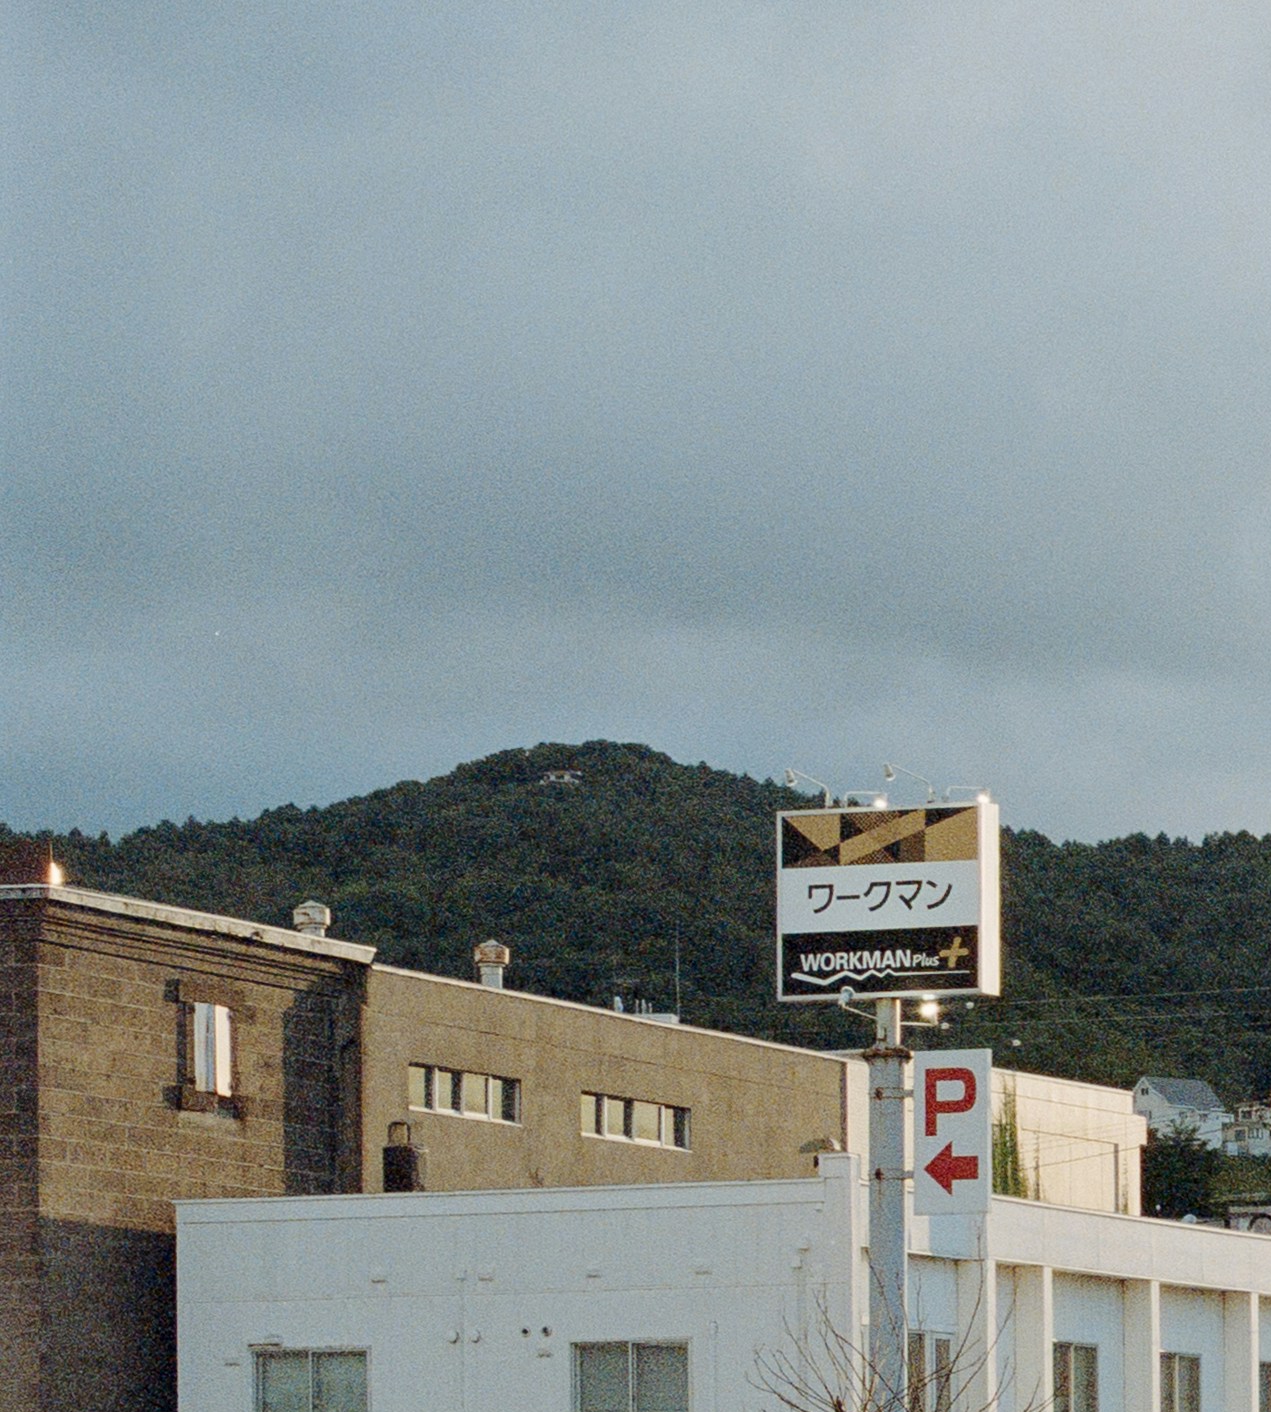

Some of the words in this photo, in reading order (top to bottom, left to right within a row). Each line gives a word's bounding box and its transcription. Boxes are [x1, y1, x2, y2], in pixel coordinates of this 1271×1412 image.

[807, 879, 953, 914] ワークマン
[924, 1067, 977, 1137] P
